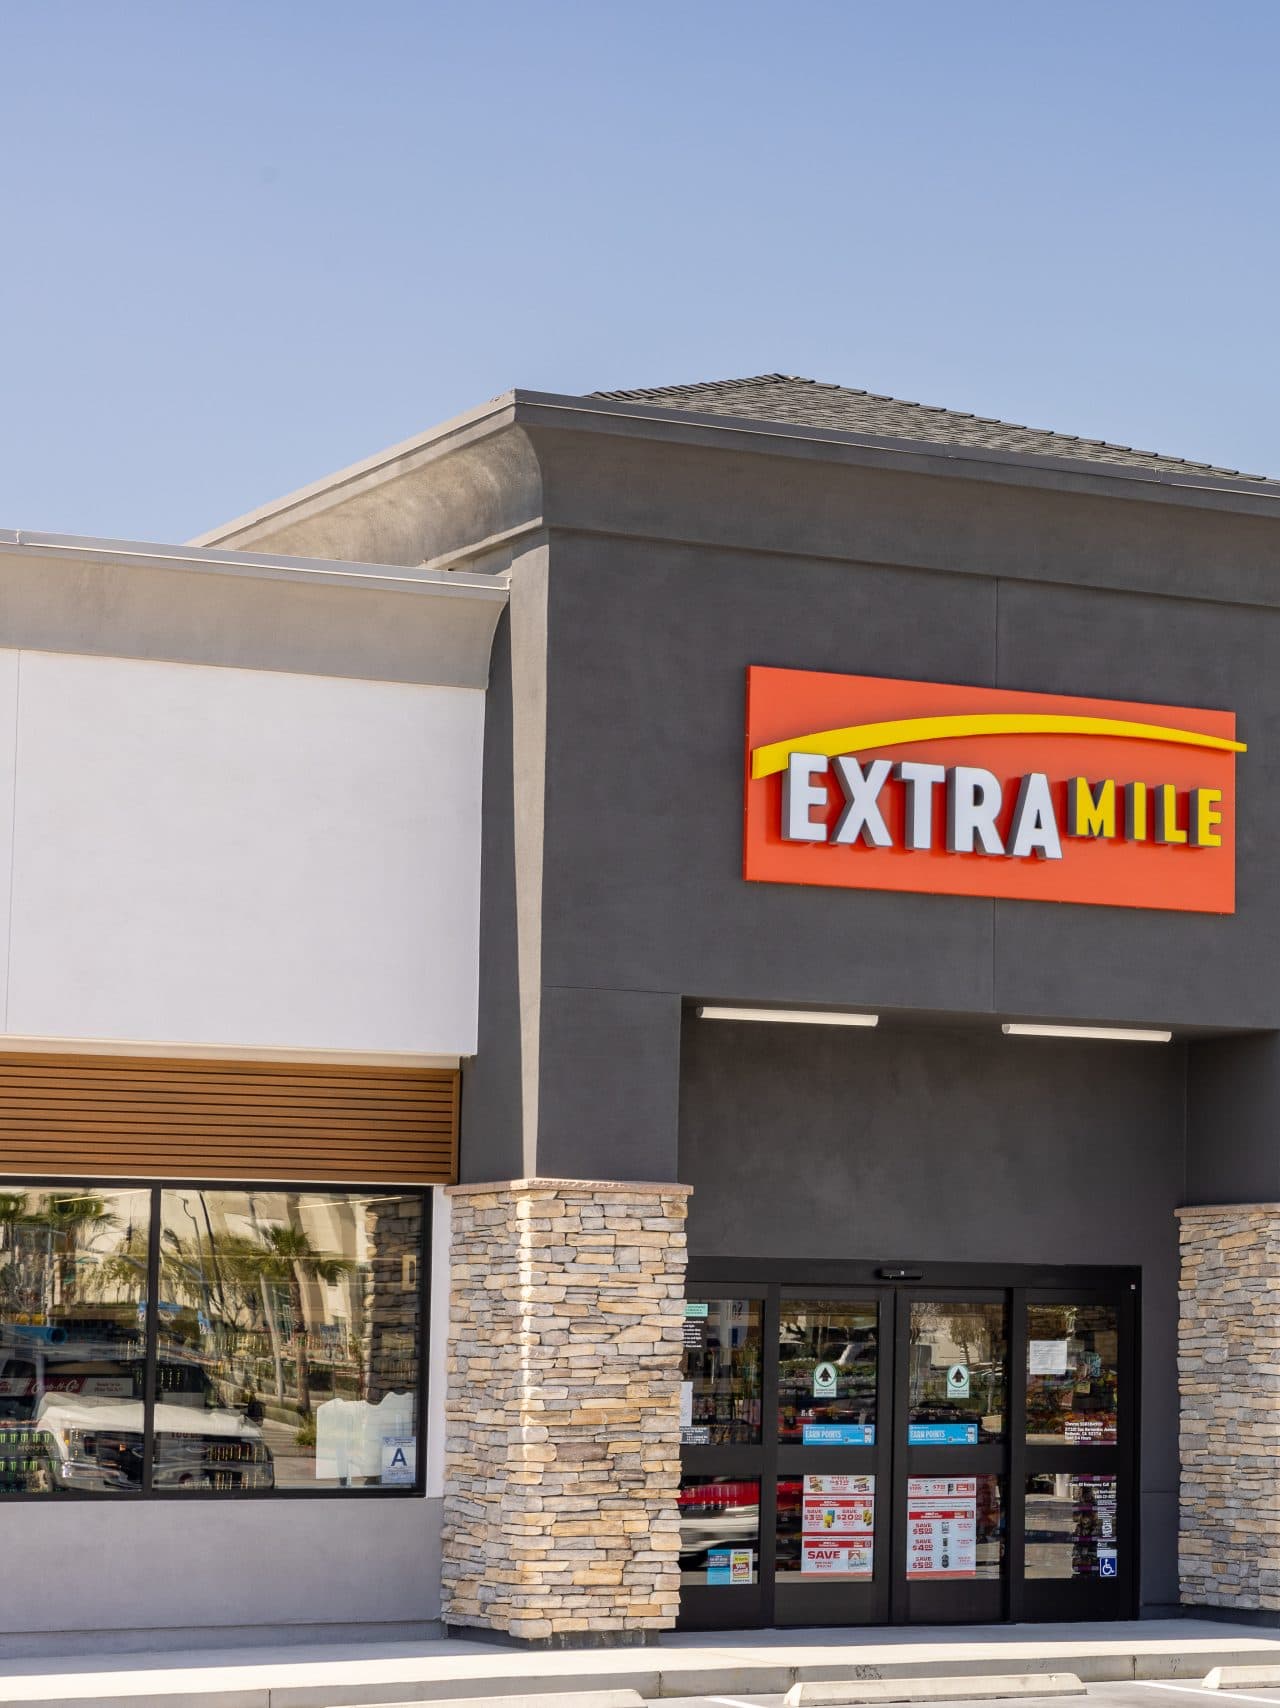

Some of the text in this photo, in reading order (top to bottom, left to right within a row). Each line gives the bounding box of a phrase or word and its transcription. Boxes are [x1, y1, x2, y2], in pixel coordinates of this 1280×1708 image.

[805, 1430, 842, 1439] EARN POINTS
[911, 1429, 946, 1439] EARN POINTS
[390, 1447, 408, 1467] A
[807, 1550, 841, 1560] SAVE
